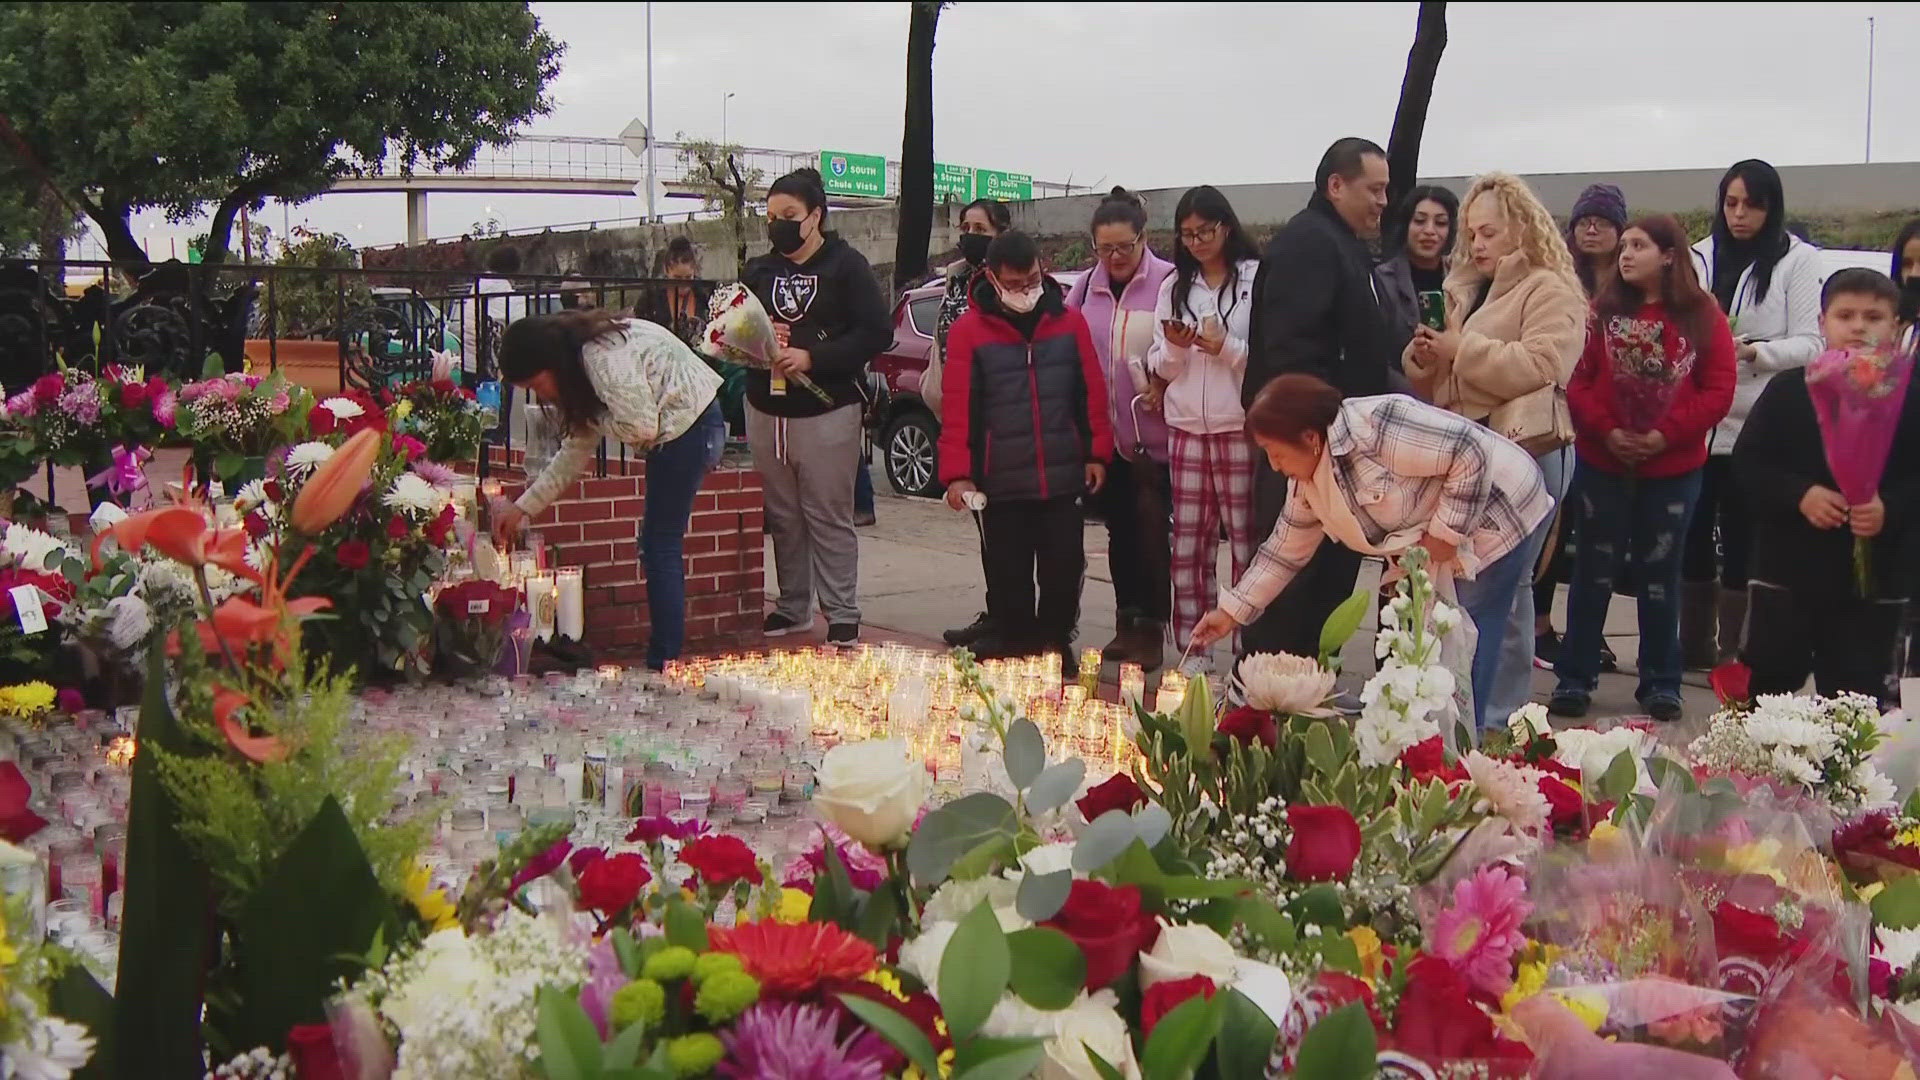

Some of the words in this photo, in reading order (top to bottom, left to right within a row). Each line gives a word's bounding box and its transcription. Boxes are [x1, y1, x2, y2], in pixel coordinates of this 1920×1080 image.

[850, 166, 876, 175] SOUTH
[941, 173, 964, 183] Street
[829, 179, 852, 189] Chula
[856, 181, 878, 191] Vista
[952, 184, 965, 193] Ave
[988, 188, 1020, 199] Coronado
